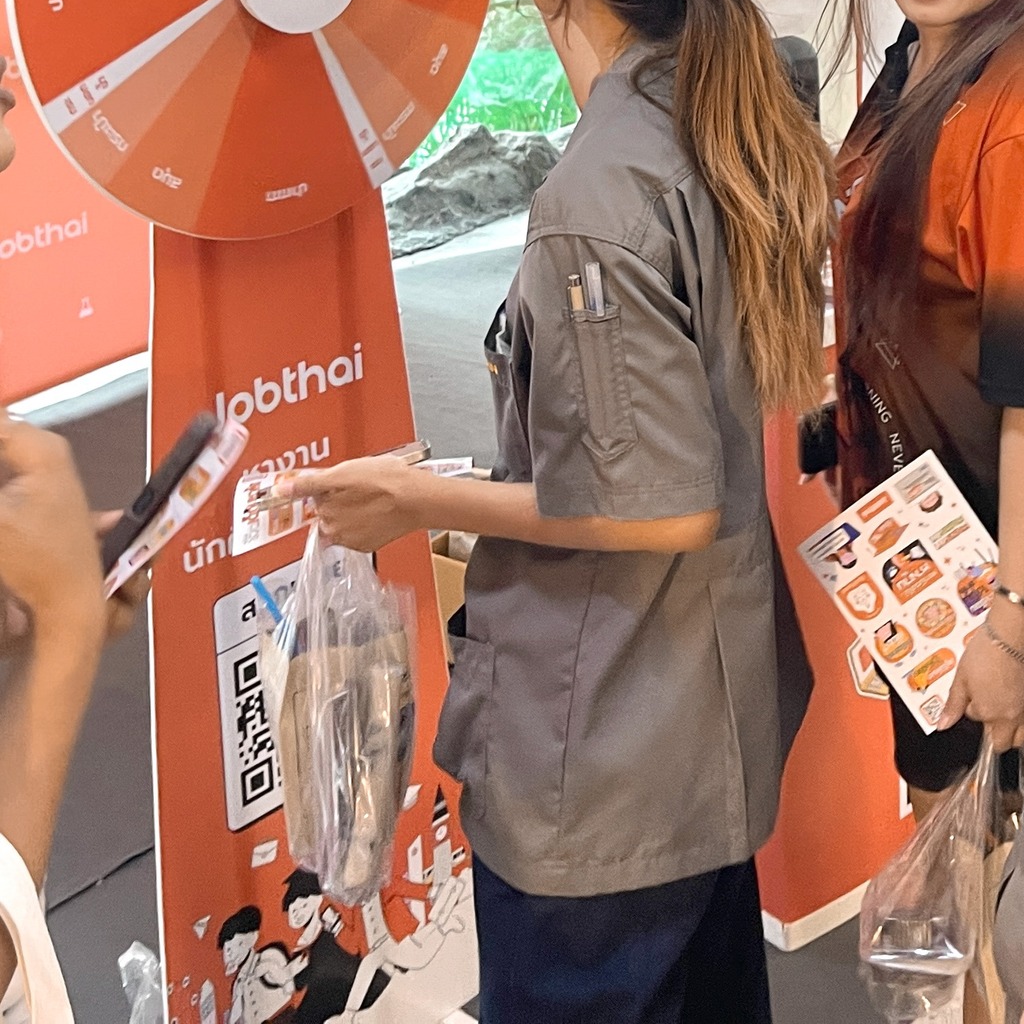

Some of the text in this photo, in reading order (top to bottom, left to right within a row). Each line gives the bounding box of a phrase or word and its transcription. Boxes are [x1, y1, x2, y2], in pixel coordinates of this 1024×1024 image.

[867, 387, 904, 473] NING NEVE
[182, 525, 235, 574] นัก
